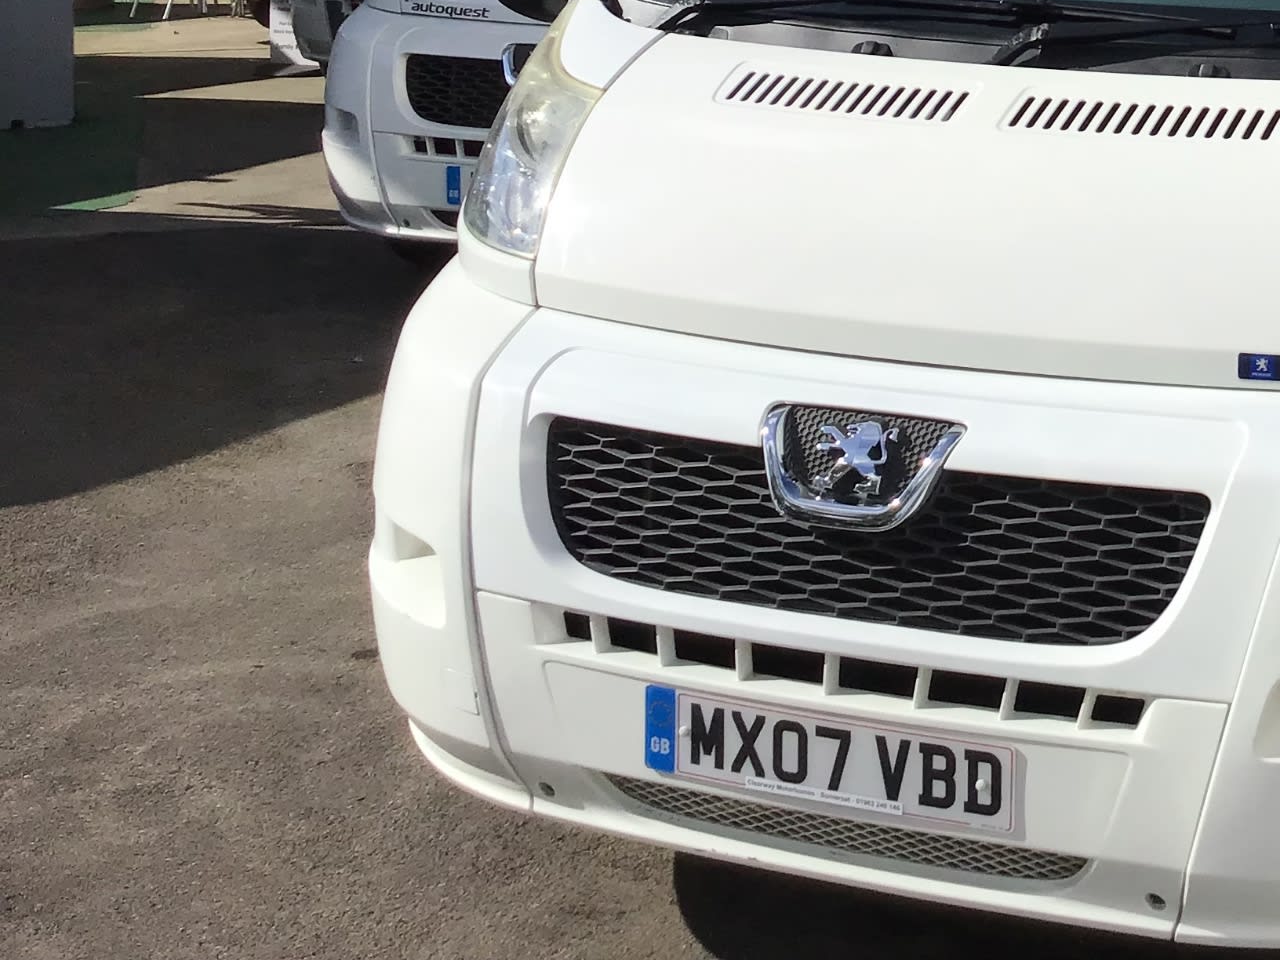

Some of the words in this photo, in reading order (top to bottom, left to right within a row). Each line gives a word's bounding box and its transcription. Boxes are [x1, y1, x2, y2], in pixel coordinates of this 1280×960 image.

[411, 1, 490, 18] autoquest
[650, 736, 671, 756] GB
[690, 702, 852, 791] MX07
[874, 734, 1003, 817] VBD
